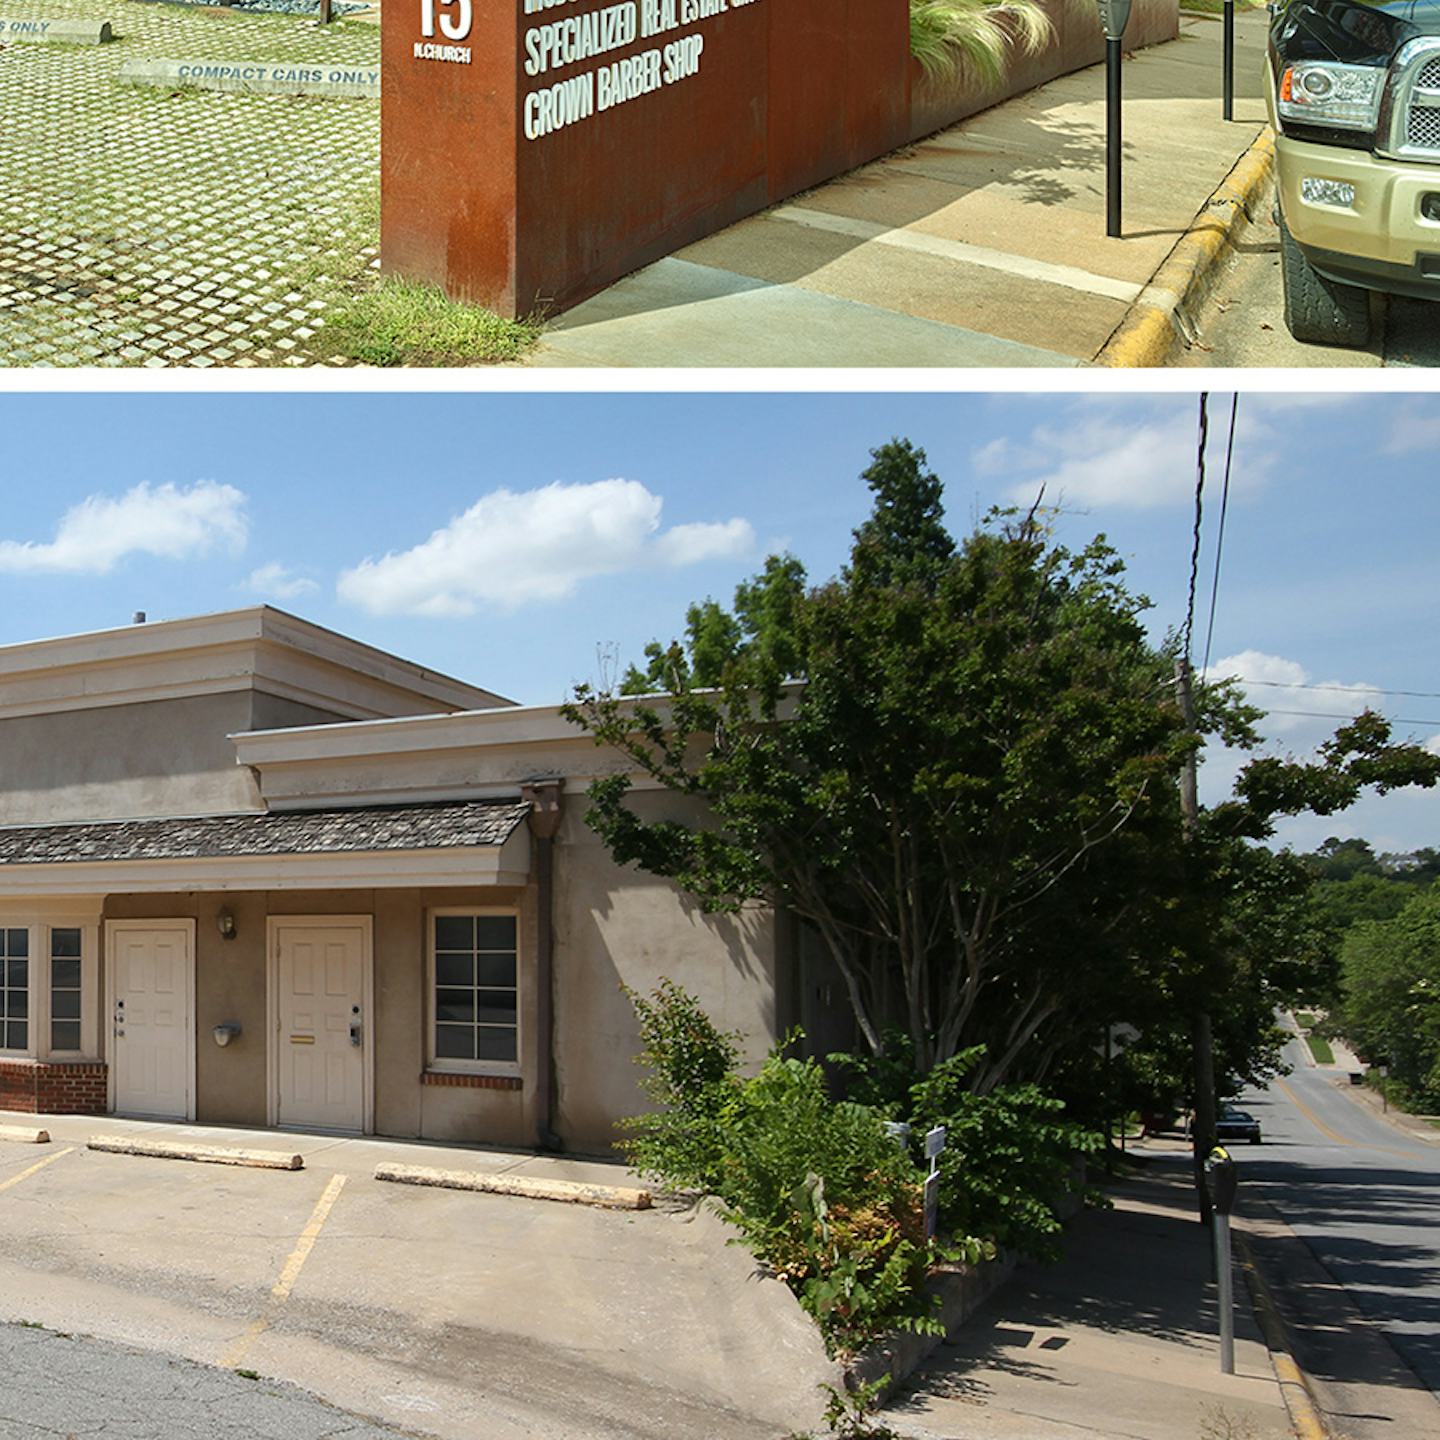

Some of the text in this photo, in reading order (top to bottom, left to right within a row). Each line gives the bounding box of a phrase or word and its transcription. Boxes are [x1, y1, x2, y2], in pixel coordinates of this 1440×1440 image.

[10, 22, 50, 33] ONLY
[524, 1, 637, 76] SPECIALIZED
[178, 65, 379, 84] COMPACT CARS ONLY
[523, 33, 704, 140] CROWN BARBER SHOP
